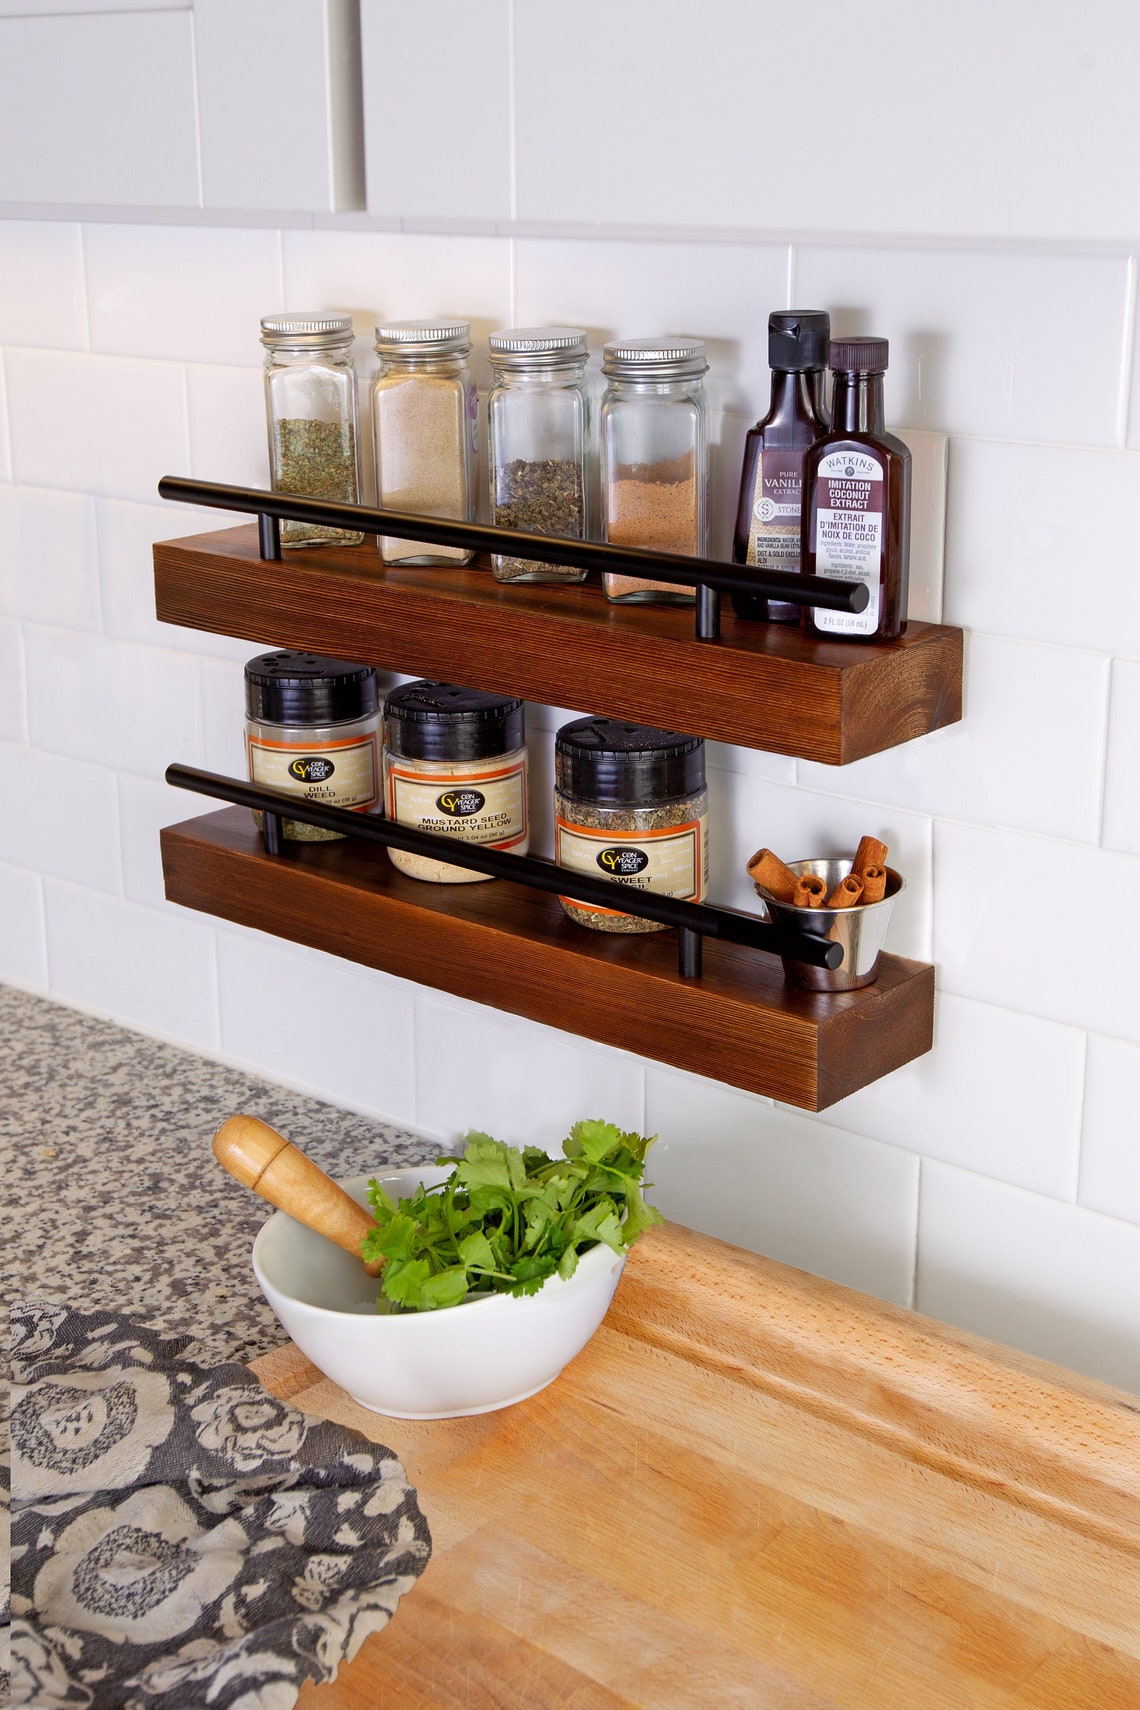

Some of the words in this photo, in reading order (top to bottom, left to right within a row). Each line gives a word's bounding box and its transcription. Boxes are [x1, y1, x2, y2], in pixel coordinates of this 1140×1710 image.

[826, 457, 874, 471] WATKINS
[764, 479, 802, 488] VANIL
[828, 480, 871, 491] IMITATION
[829, 489, 870, 500] COCONUT
[830, 499, 869, 509] EXTRACT
[833, 513, 865, 522] EXTRAIT
[820, 521, 866, 531] D'IMITATION
[868, 525, 878, 533] DE
[822, 530, 840, 539] NOIX
[842, 532, 852, 540] DE
[854, 533, 876, 542] COCO
[823, 617, 828, 625] 2
[836, 618, 844, 626] OZ
[422, 818, 477, 826] MUSTARD
[480, 812, 507, 823] SEED
[417, 824, 466, 832] GROUND
[470, 818, 512, 831] YELLOW
[610, 876, 653, 884] SWEET
